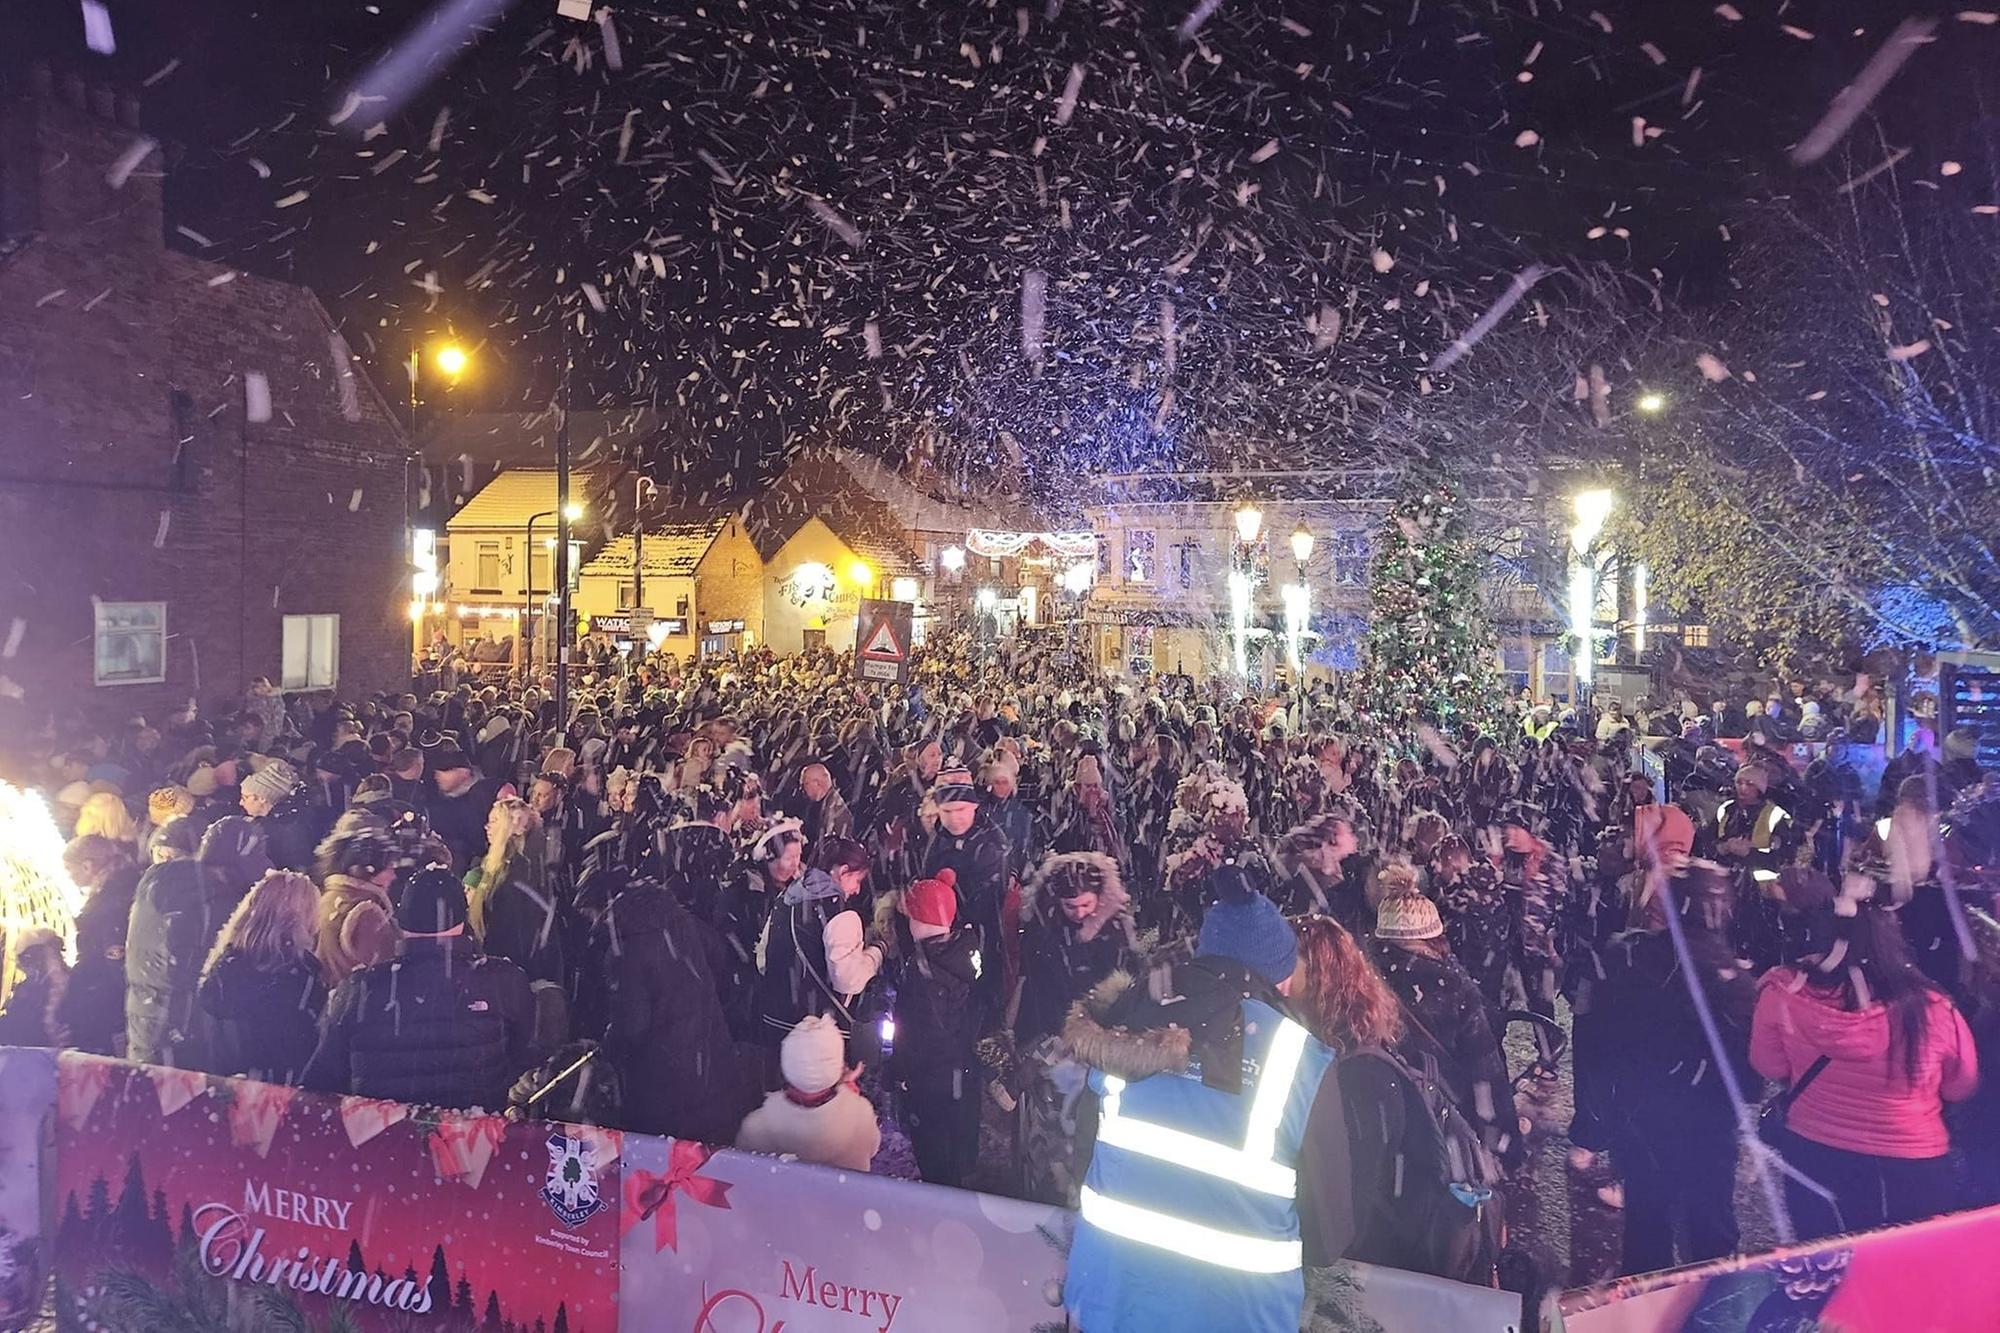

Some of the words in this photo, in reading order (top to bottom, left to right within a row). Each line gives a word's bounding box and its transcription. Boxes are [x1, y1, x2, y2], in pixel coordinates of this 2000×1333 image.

[828, 590, 859, 604] CHIPS
[244, 1178, 353, 1231] MERRY
[549, 1198, 589, 1220] KIMBERLEY
[535, 1235, 564, 1250] Kimberley
[564, 1243, 580, 1254] Town
[580, 1248, 609, 1258] Council
[550, 1228, 580, 1243] Supported
[580, 1236, 590, 1246] by
[192, 1202, 433, 1314] Christmas
[779, 1259, 902, 1332] Merry
